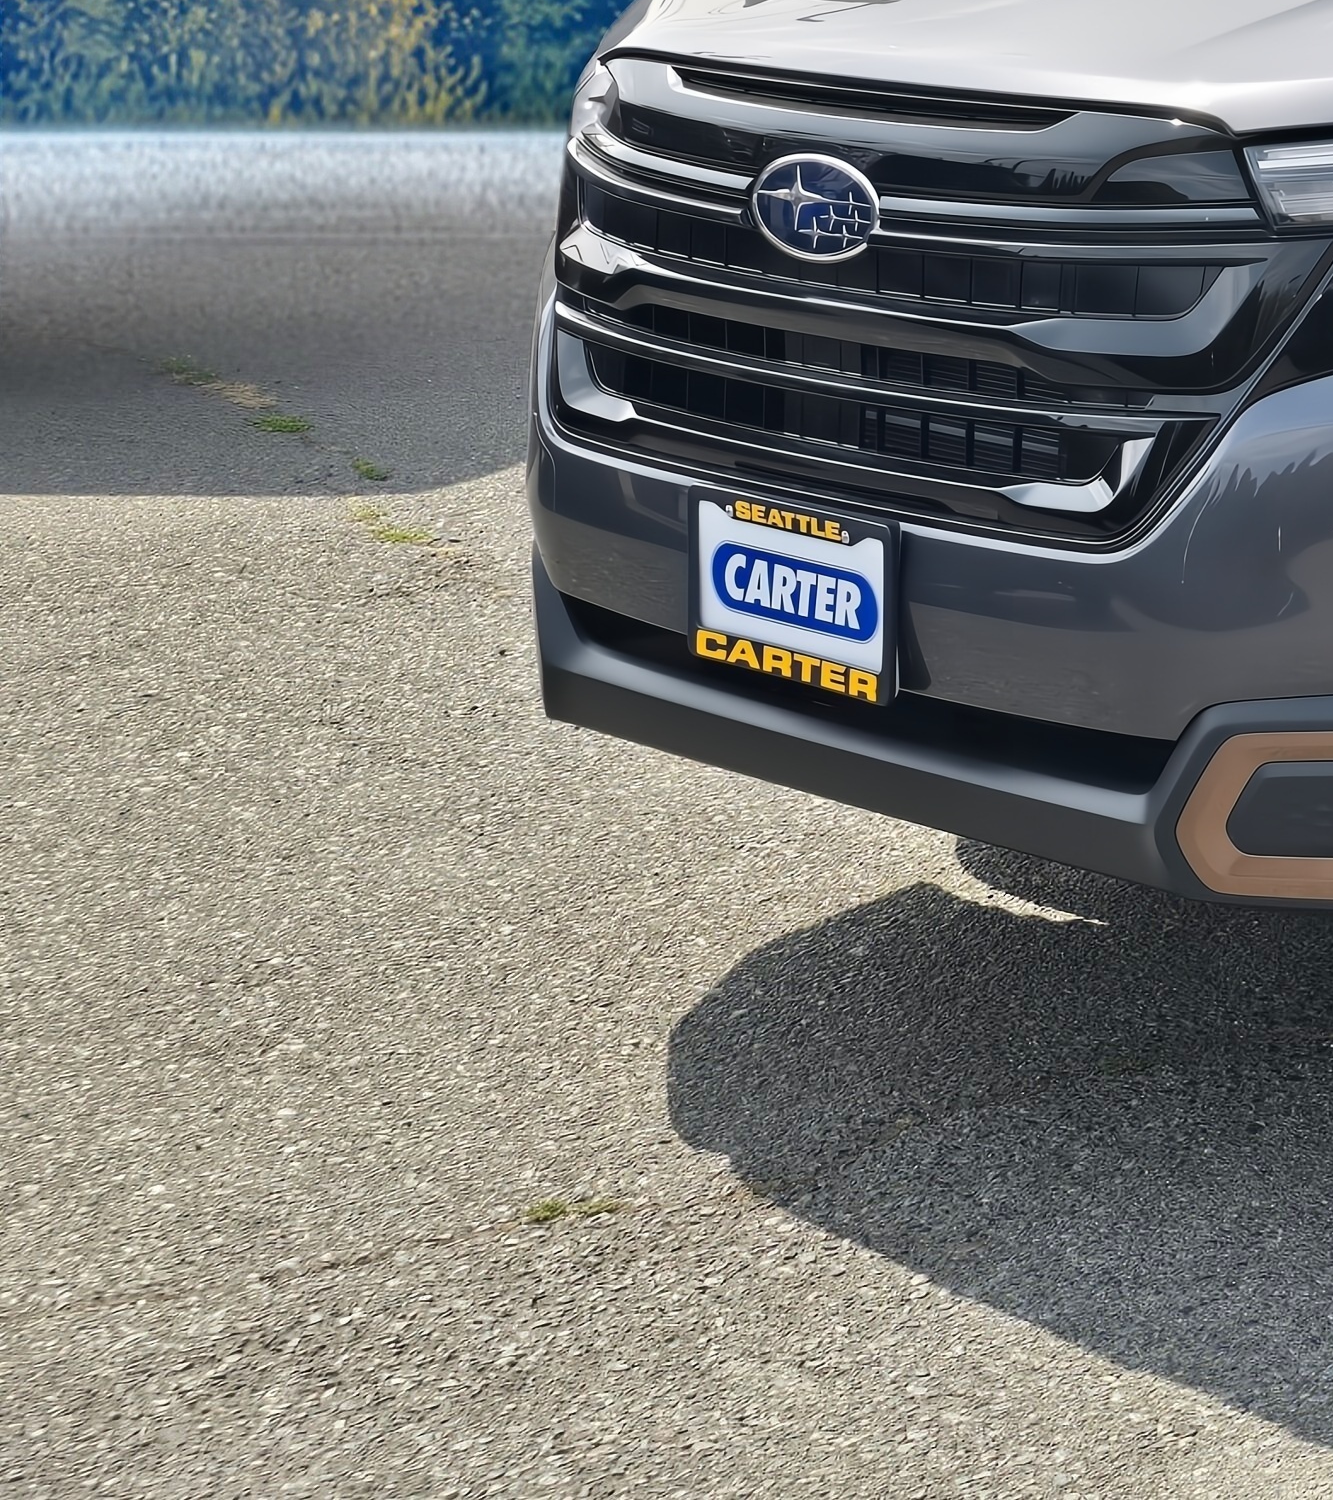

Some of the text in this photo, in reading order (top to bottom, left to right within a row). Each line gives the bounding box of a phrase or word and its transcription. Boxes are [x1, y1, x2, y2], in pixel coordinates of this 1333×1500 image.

[734, 499, 842, 542] SEATTLE
[723, 552, 862, 630] CARTER
[695, 628, 879, 703] CARTER
